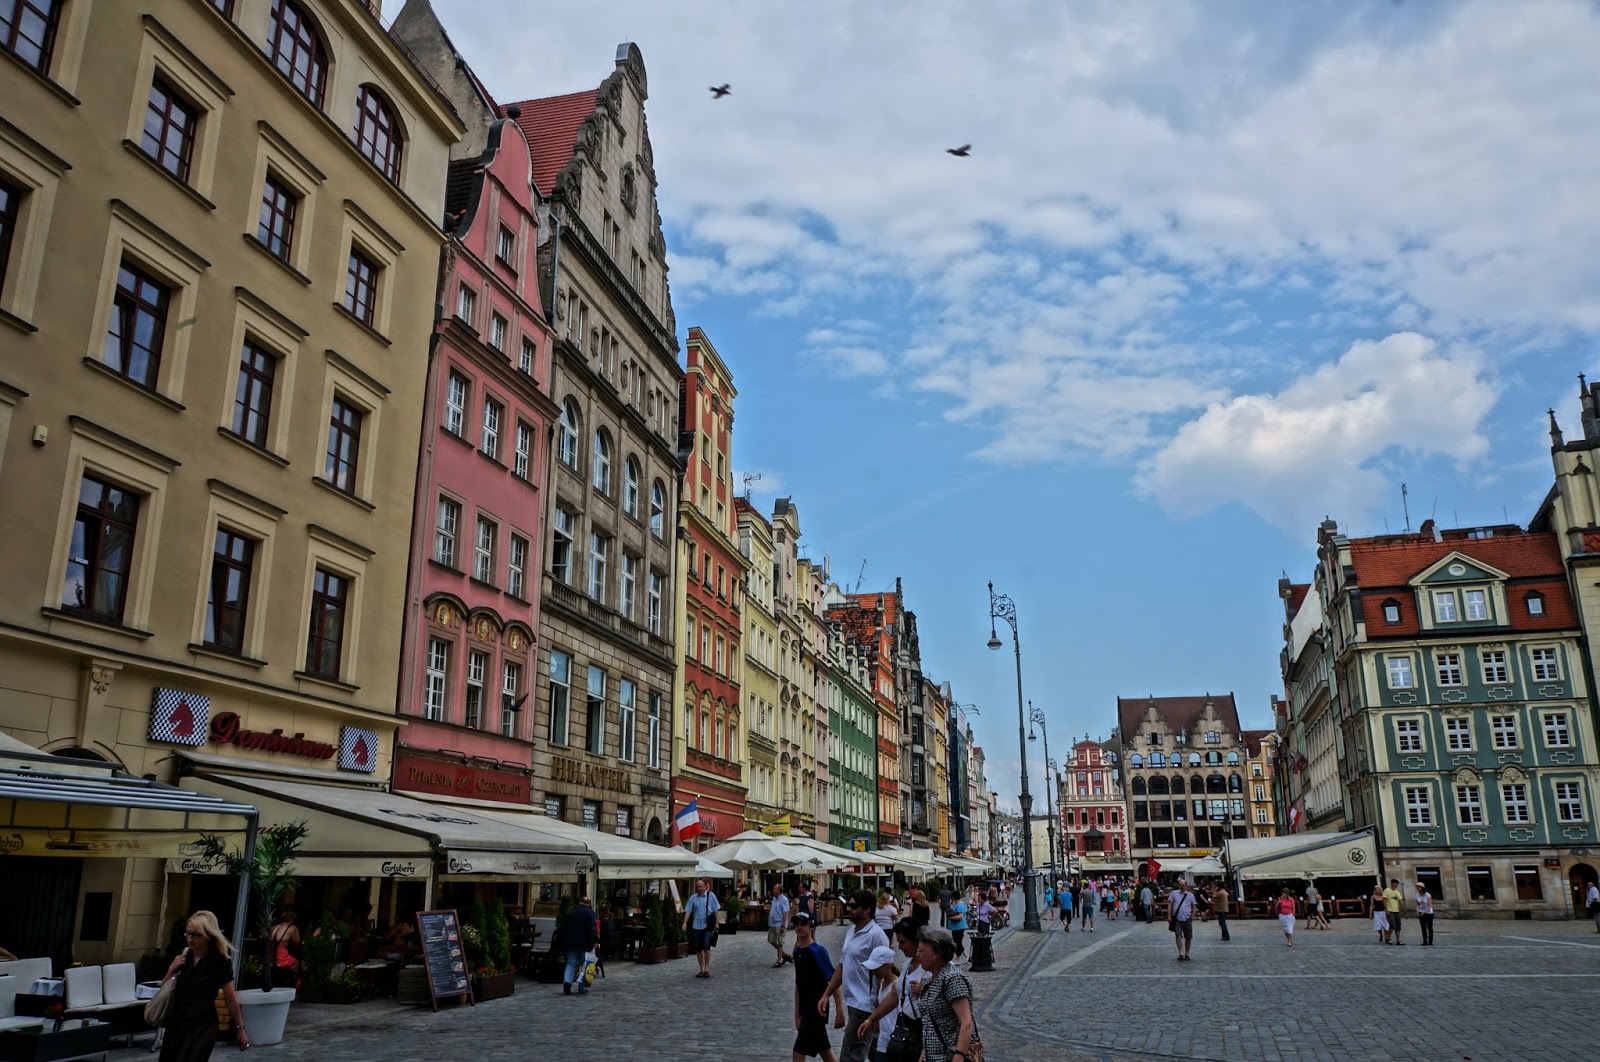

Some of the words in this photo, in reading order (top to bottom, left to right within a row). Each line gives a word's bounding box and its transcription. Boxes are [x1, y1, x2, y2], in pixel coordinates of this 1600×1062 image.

[208, 712, 338, 759] Dominium
[552, 756, 632, 794] BIBLIOTEKA
[181, 859, 212, 873] Carlsberg
[382, 861, 415, 876] Carlsberg
